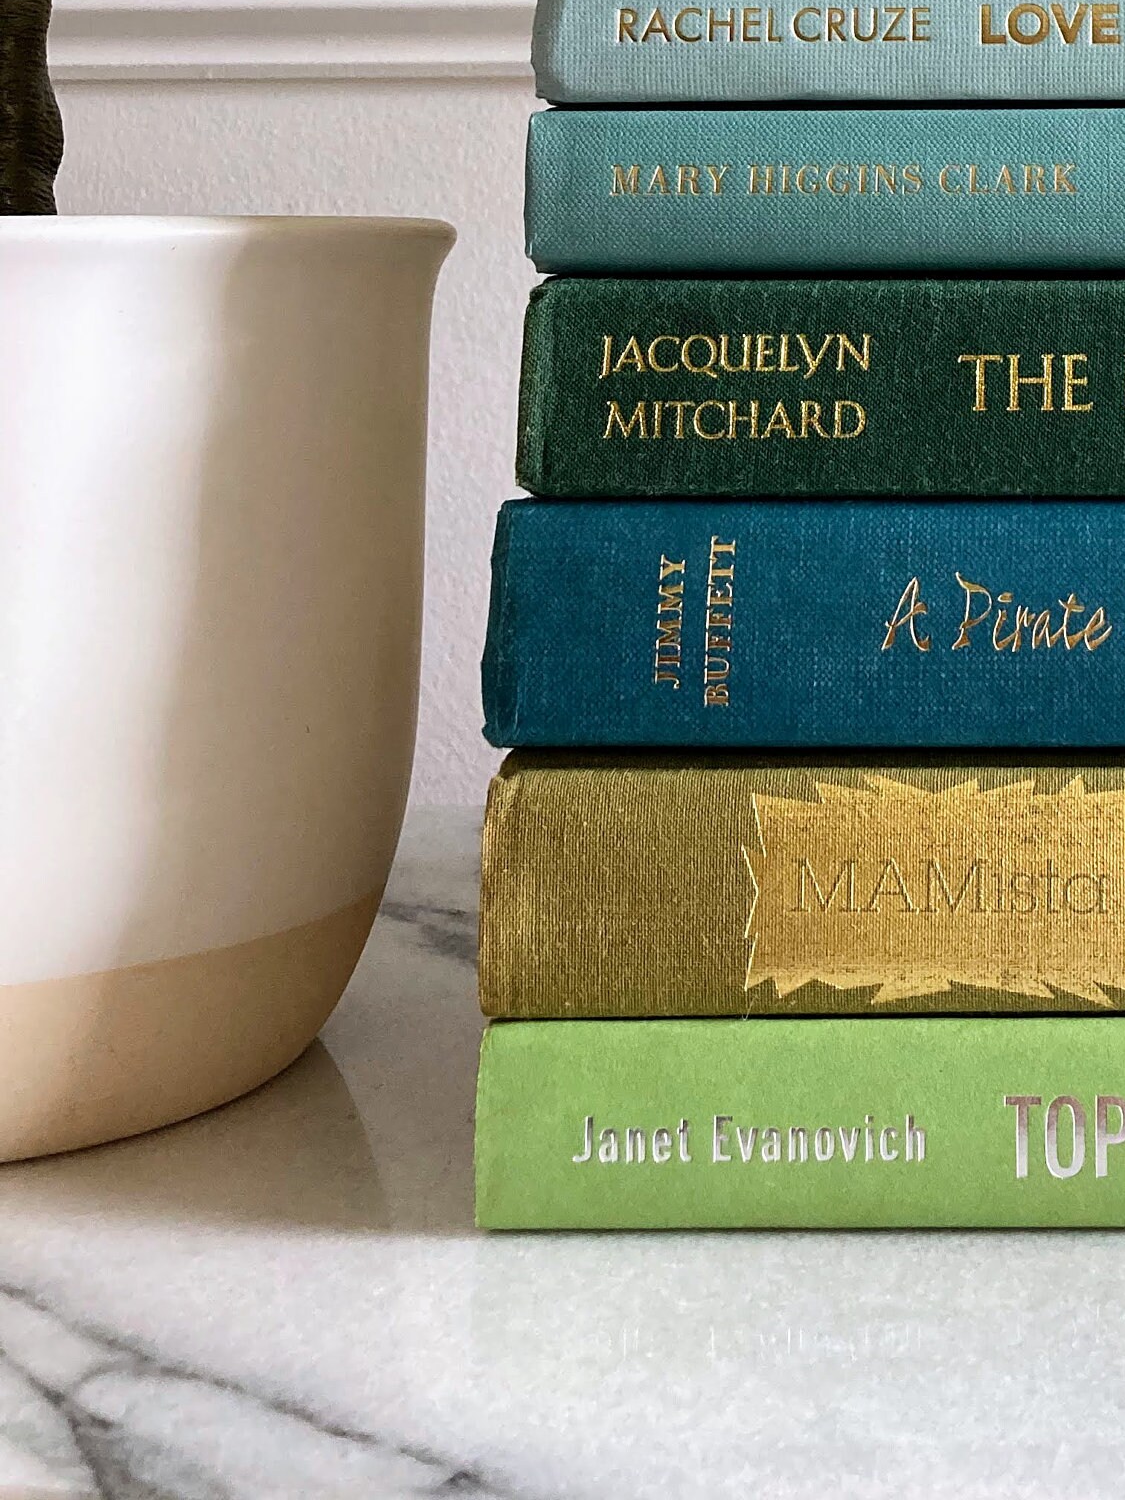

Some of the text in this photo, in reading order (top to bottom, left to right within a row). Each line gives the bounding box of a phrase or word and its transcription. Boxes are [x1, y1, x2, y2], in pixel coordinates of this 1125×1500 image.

[618, 7, 932, 44] RACHEL CRUZE
[981, 3, 1121, 46] LOVE
[611, 163, 1079, 197] MARY HIGGINS CLARK
[599, 334, 872, 380] JACQUELYN
[958, 353, 1093, 412] THE
[603, 400, 867, 440] MITCHARD
[653, 555, 687, 690] JIMMY
[703, 534, 738, 707] BUFFETT
[880, 575, 931, 653] A
[950, 571, 1114, 653] Pirate
[791, 854, 1114, 914] MAMista
[572, 1113, 928, 1164] Janet Evanovich
